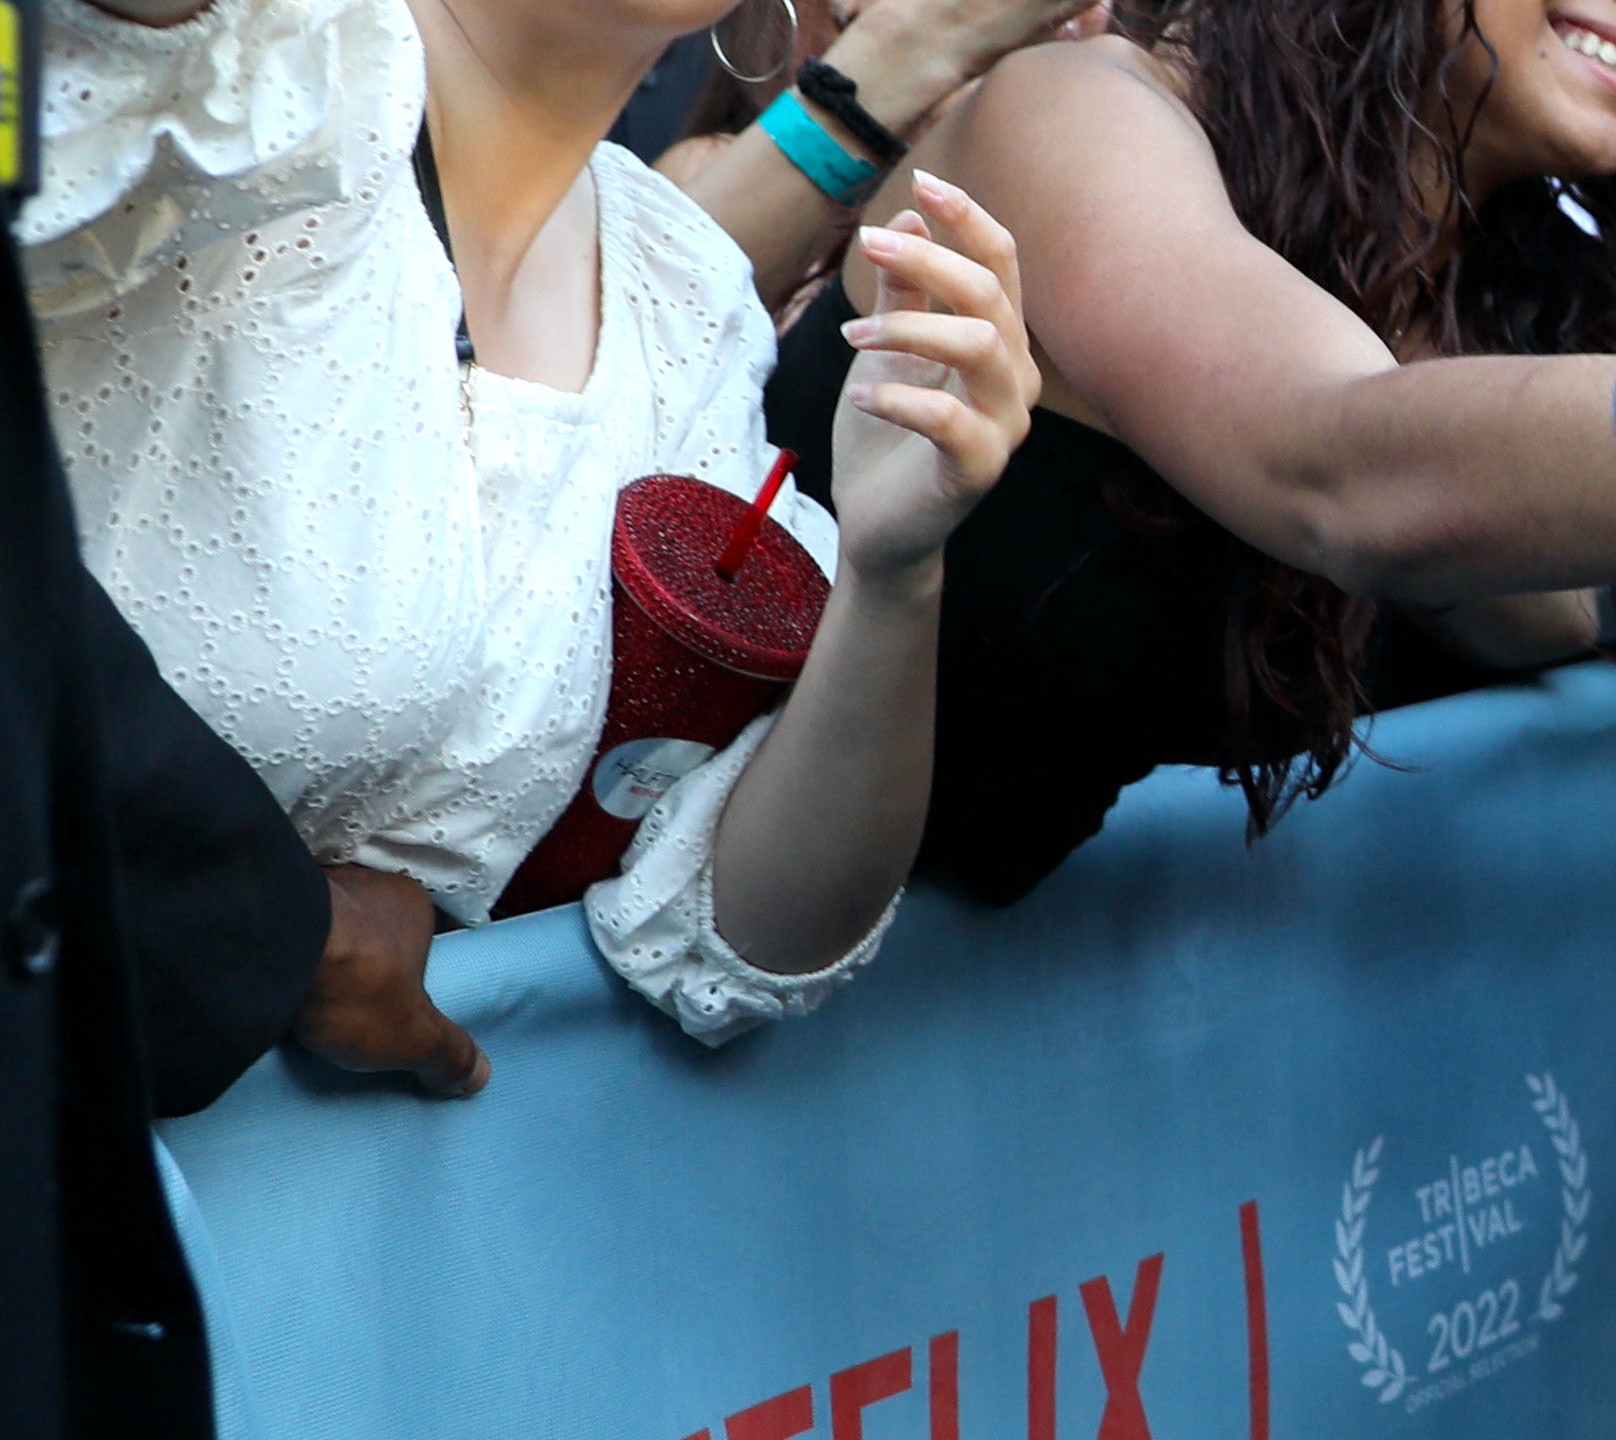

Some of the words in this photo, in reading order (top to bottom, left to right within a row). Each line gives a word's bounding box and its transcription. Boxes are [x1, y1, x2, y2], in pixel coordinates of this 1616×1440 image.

[1415, 1144, 1538, 1223] TRIBECA
[1388, 1199, 1525, 1287] FESTIVAL
[1427, 1278, 1521, 1371] 2022
